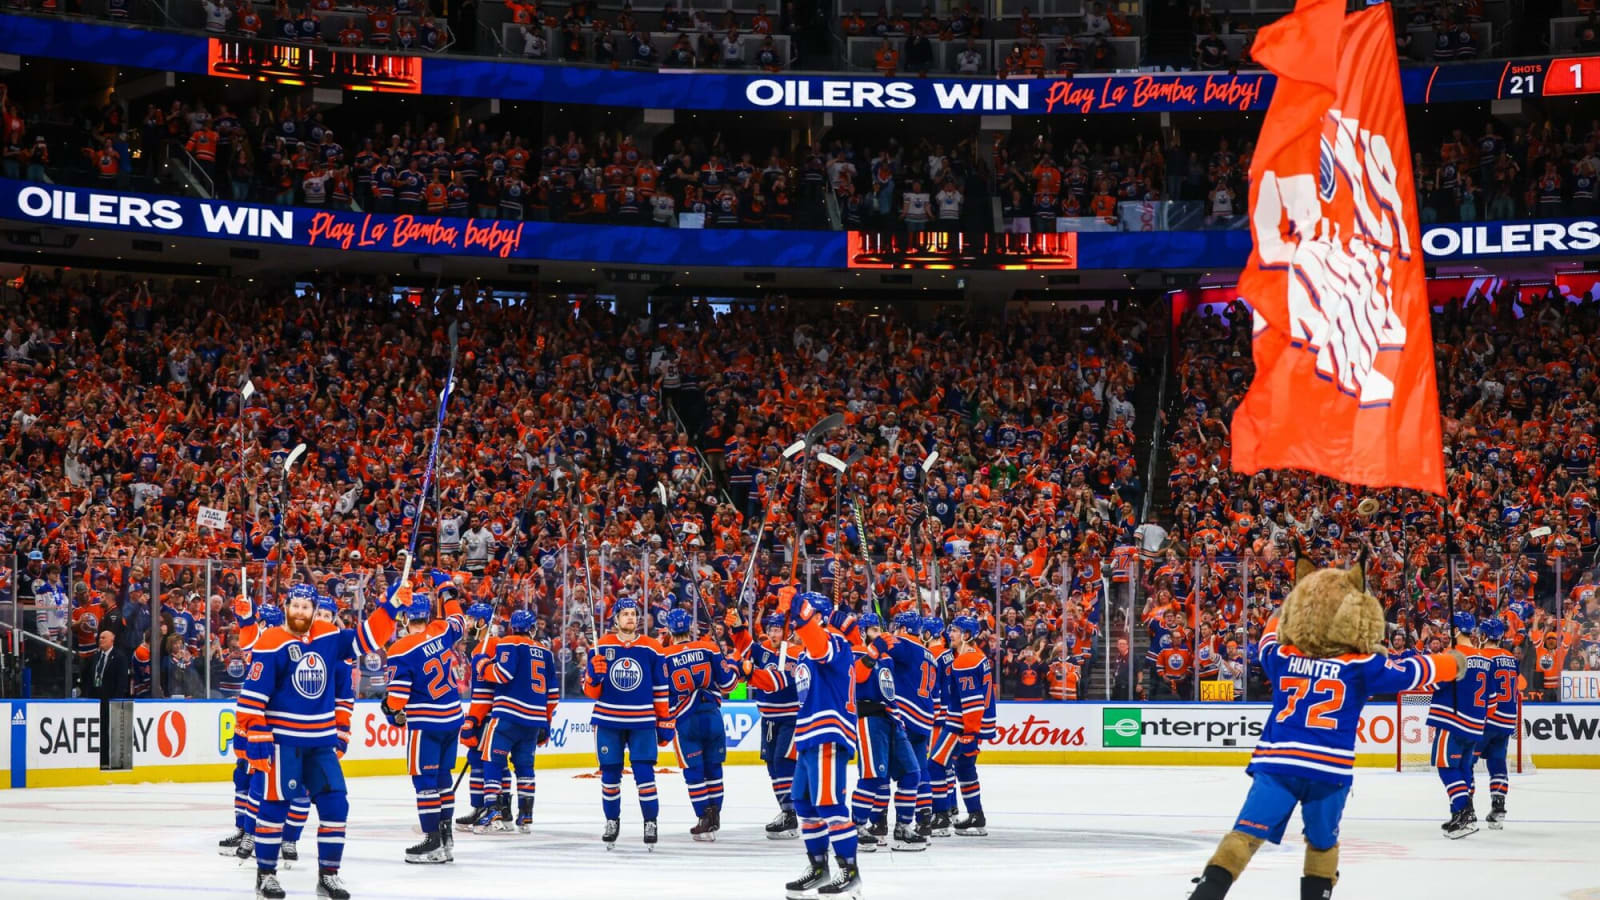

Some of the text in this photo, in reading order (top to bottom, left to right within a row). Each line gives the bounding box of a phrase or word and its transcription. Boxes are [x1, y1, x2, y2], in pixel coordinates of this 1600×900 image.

[1511, 65, 1542, 74] SHOTS
[1569, 63, 1582, 89] 1
[746, 74, 1263, 113] OILERS WIN Play La Bamba, baby!
[1510, 75, 1535, 94] 21
[17, 186, 525, 258] OILERS WIN Play La Bamba, baby!
[1421, 221, 1600, 257] OILERS
[672, 651, 704, 668] McDAVID
[1287, 656, 1341, 680] HUNTER
[299, 669, 324, 681] OILERS
[531, 659, 546, 694] 5
[614, 669, 639, 681] OILERS
[671, 662, 711, 693] 97
[959, 676, 976, 691] 71
[1473, 671, 1487, 707] 2
[1494, 669, 1519, 703] 37
[1201, 682, 1234, 700] BELIEVE
[1275, 676, 1347, 730] 72
[987, 714, 1086, 746] ortons
